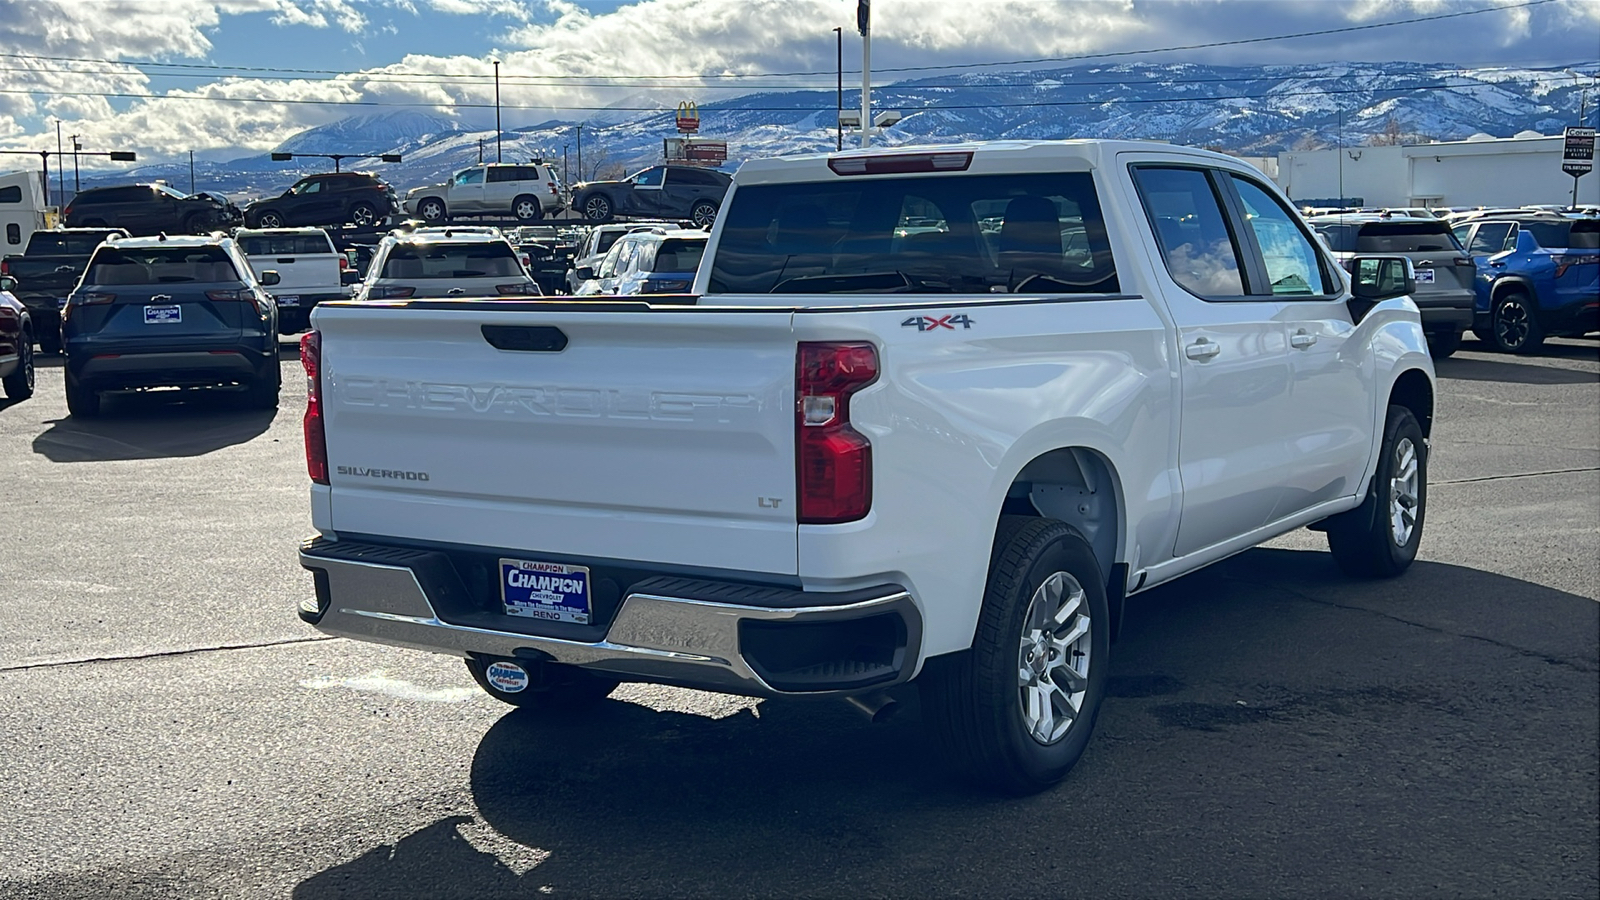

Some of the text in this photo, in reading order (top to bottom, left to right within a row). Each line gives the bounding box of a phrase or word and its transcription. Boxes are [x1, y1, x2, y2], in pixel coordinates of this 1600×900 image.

[342, 377, 755, 423] CHEVROLET
[337, 465, 430, 482] SILVERADO
[758, 496, 783, 509] LT
[523, 562, 563, 573] CHAMPION
[508, 569, 583, 594] CHAMPION
[532, 592, 562, 601] CHEVROLET
[533, 610, 561, 620] RENO
